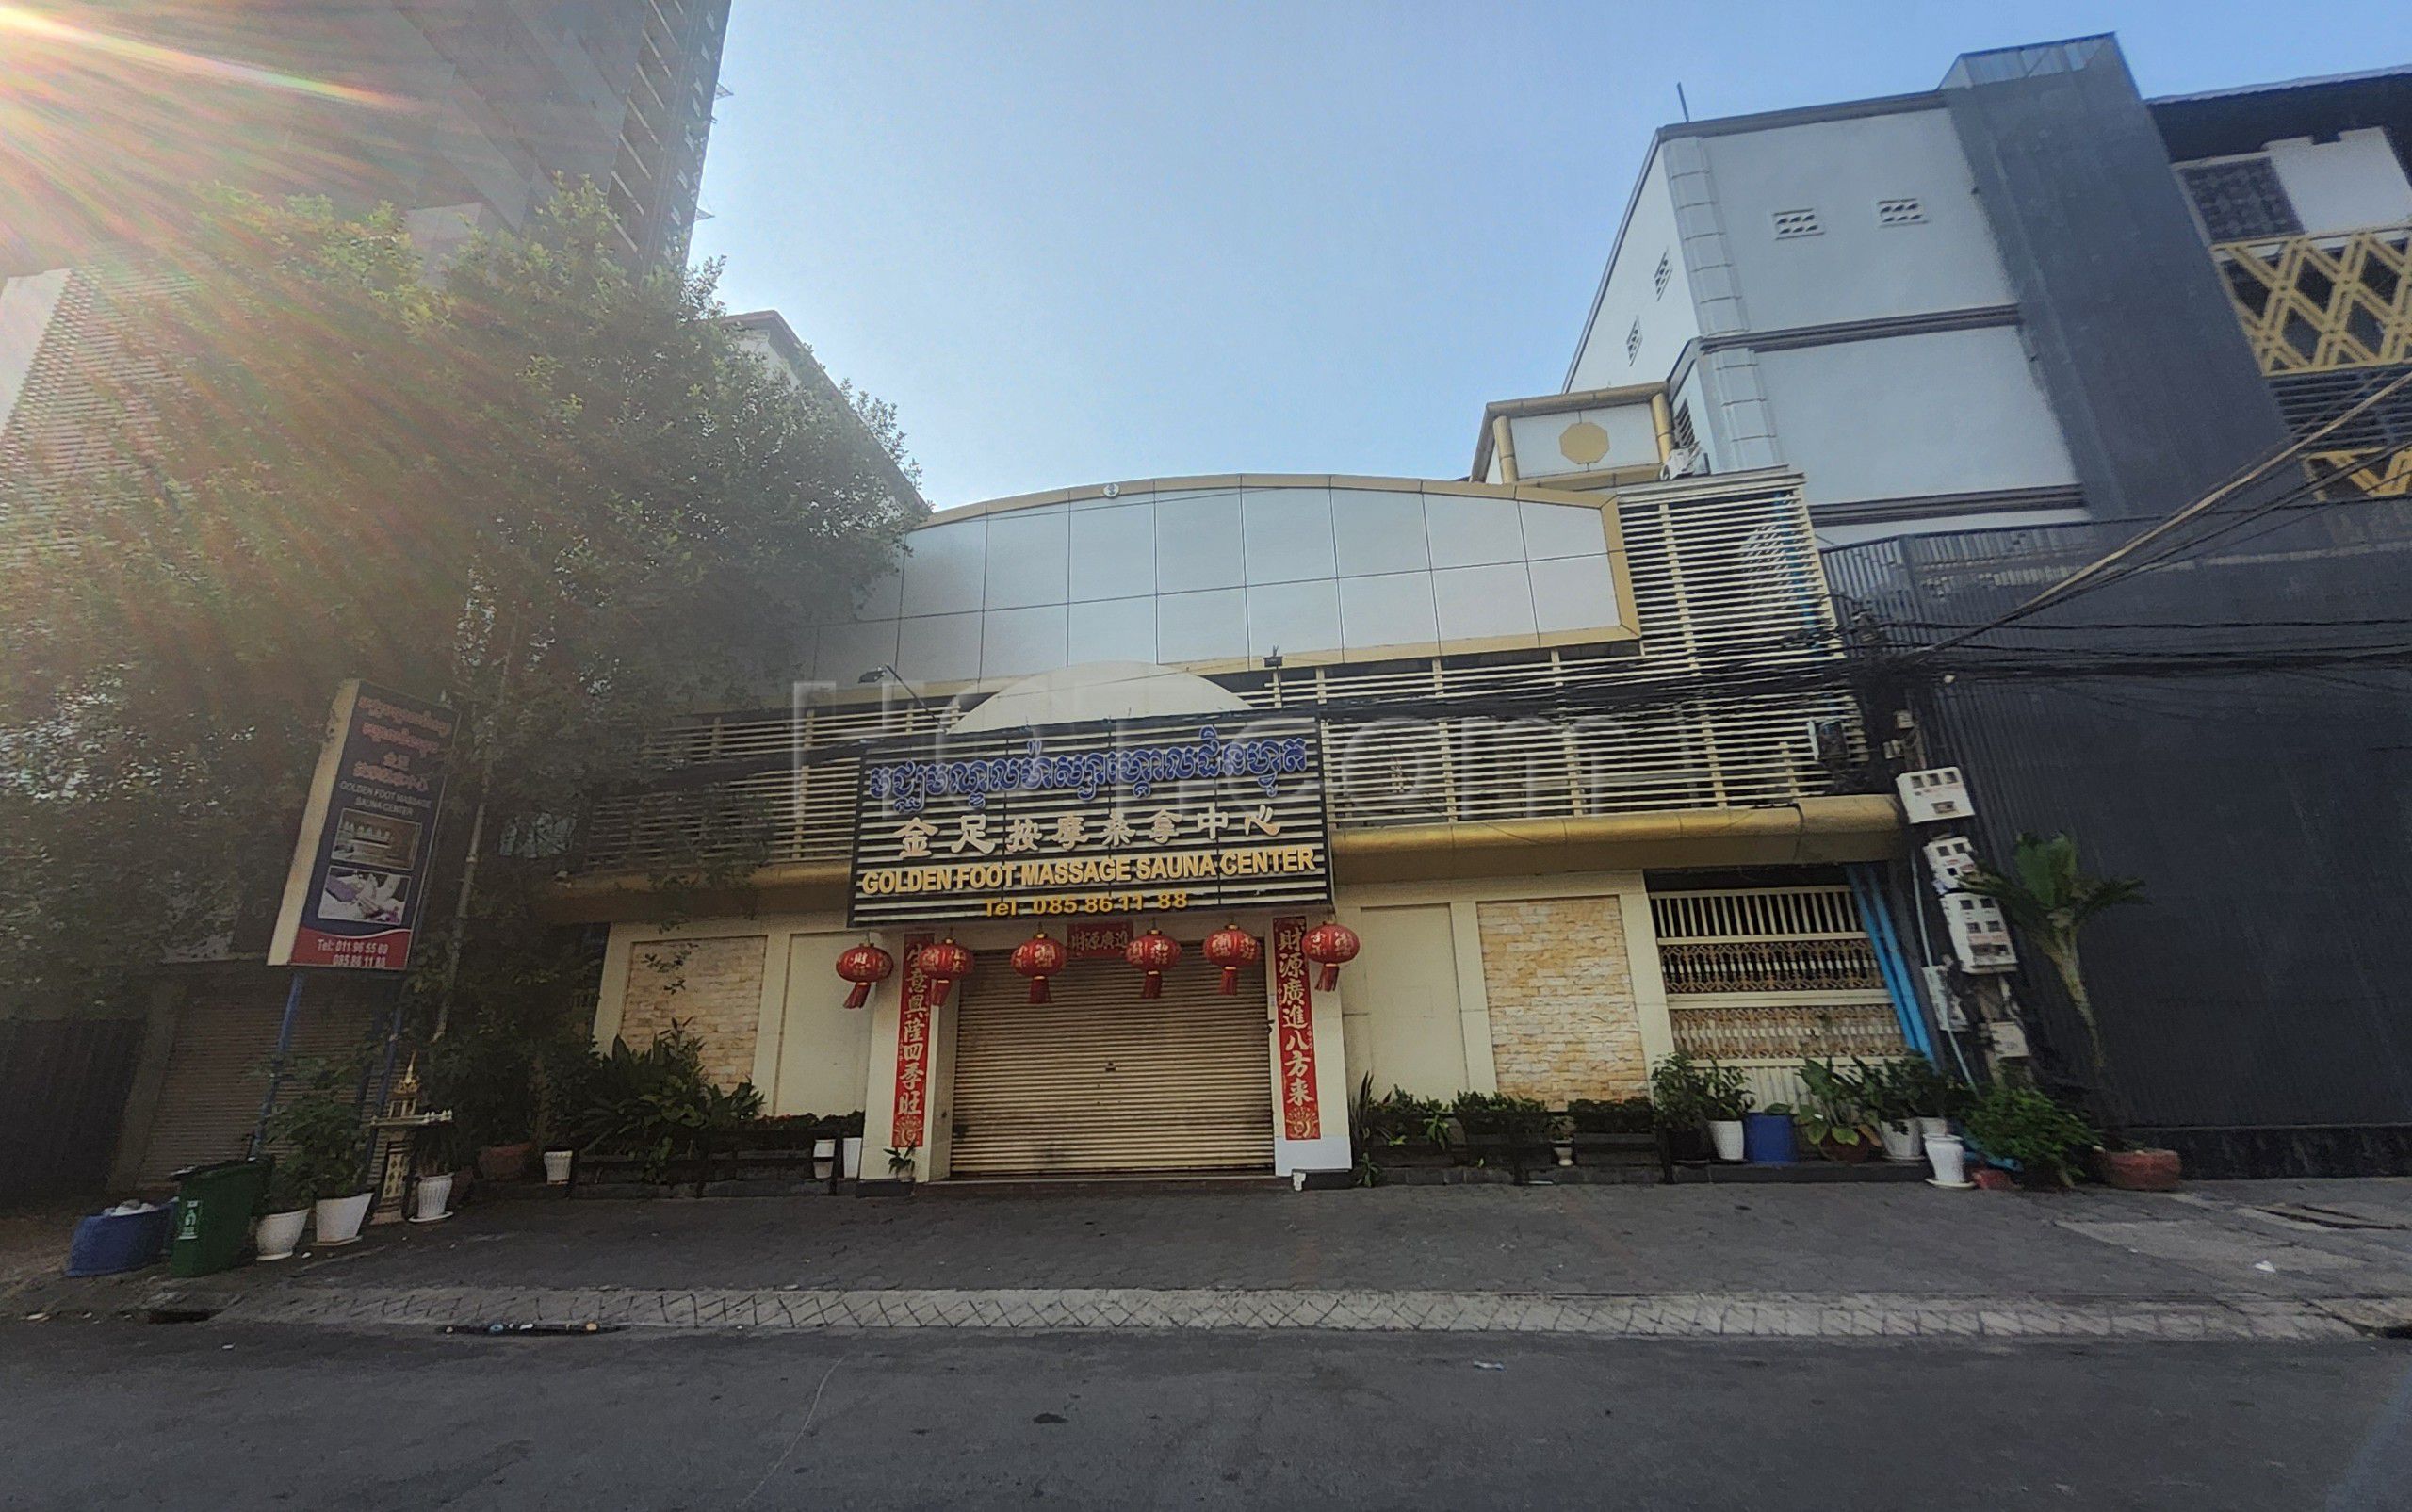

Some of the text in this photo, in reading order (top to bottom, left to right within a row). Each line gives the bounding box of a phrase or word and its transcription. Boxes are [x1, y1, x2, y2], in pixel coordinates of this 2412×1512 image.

[892, 803, 1282, 860] 金足按摩桑拿中心
[862, 847, 1317, 895] GOLDEN FOOT MASSAGE SAUNA CENTER
[1033, 894, 1078, 915] 085
[1084, 895, 1114, 914] 86
[1118, 893, 1144, 911] 11
[1157, 888, 1189, 909] 88
